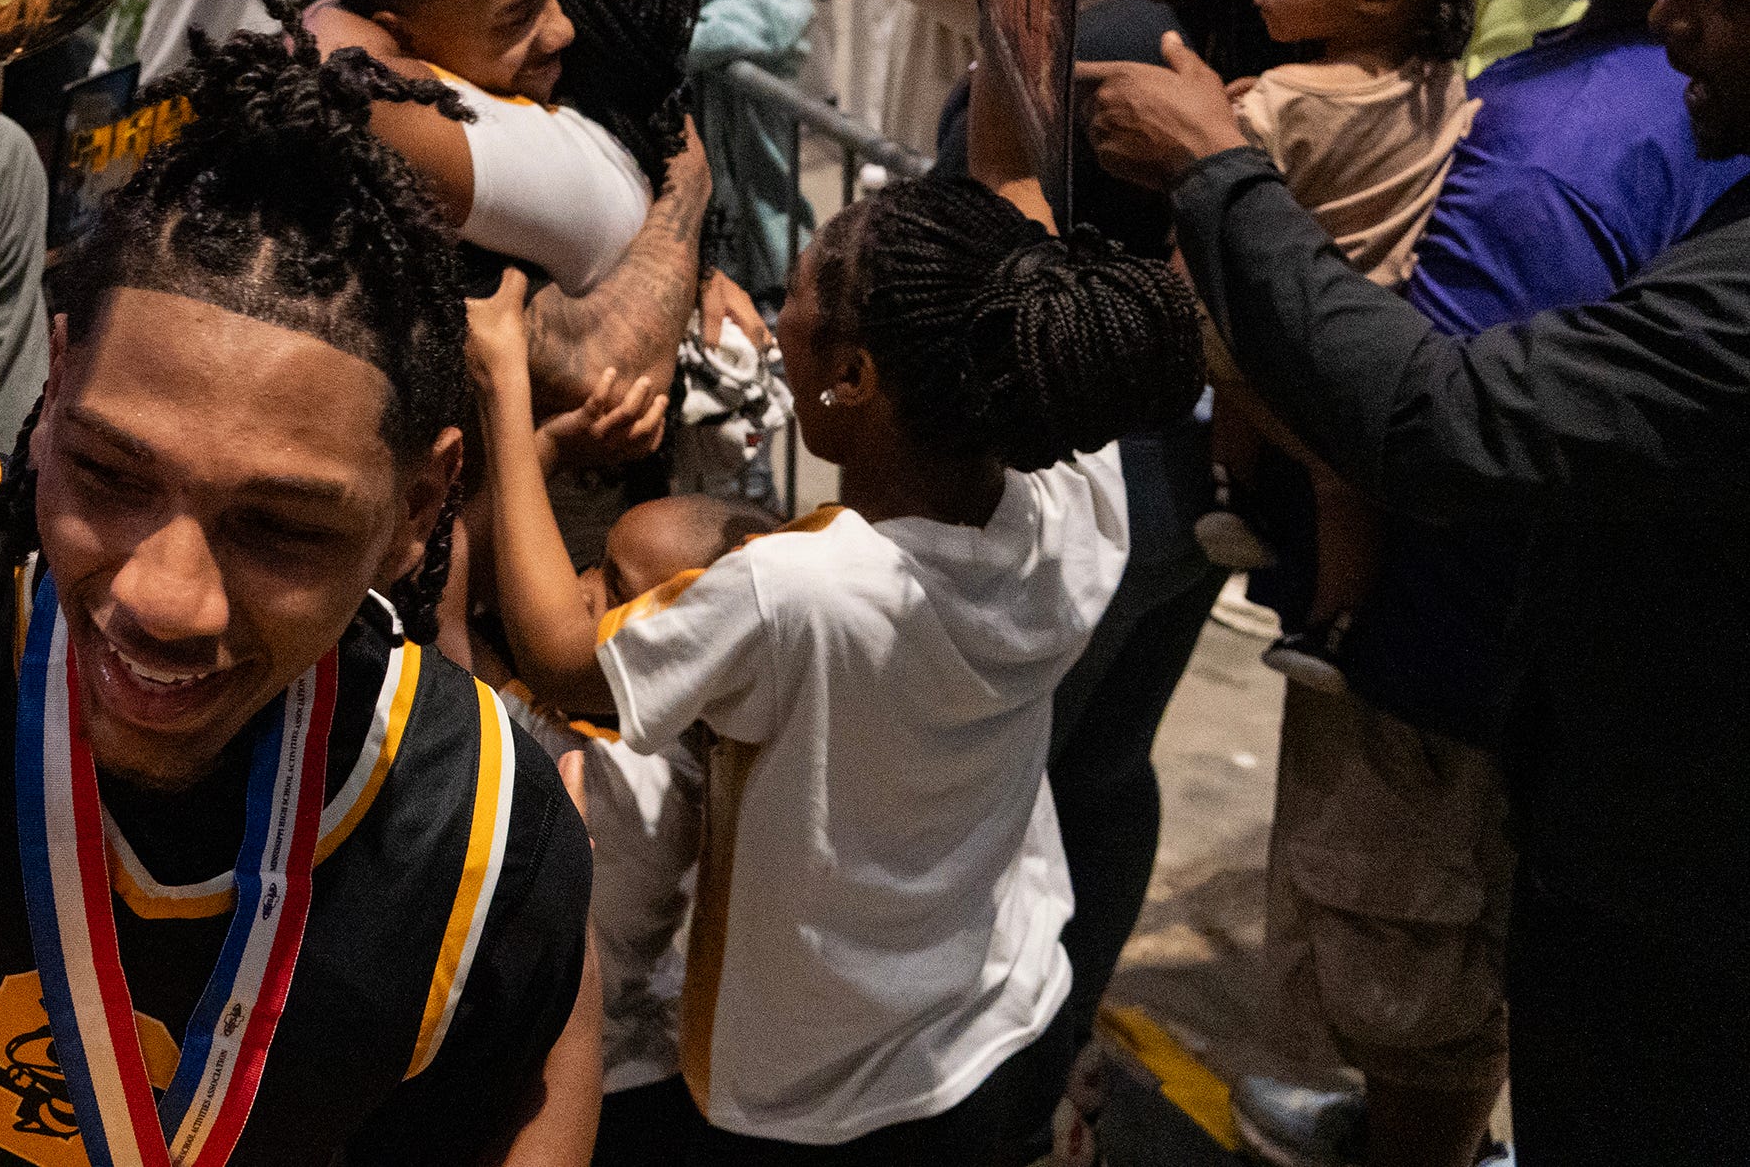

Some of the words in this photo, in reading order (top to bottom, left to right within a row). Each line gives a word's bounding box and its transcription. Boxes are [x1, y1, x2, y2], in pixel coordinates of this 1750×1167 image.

[294, 678, 305, 729] ASSOCIATION
[288, 729, 299, 772] ACTIVITIES
[282, 776, 293, 806] SCHOOL
[279, 807, 288, 827] HIGH
[269, 828, 284, 872] MISSISSIPPI
[179, 1132, 196, 1157] SCHOOL
[191, 1099, 211, 1133] ACTIVITIES
[206, 1049, 227, 1100] ASSOCIATION
